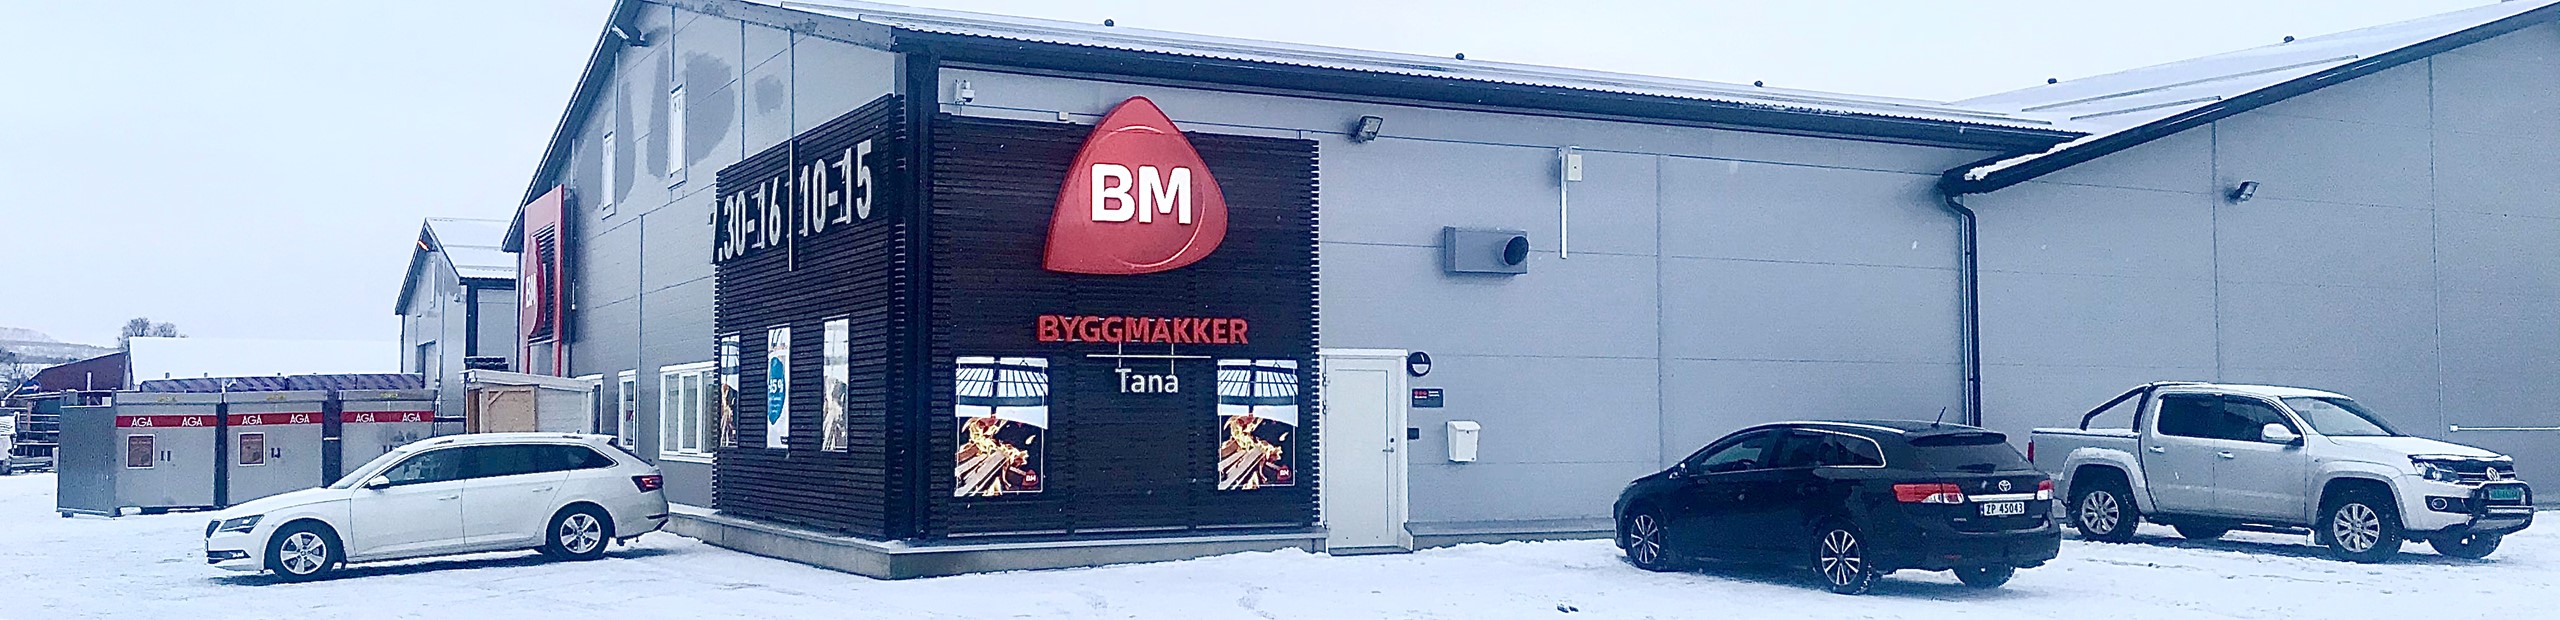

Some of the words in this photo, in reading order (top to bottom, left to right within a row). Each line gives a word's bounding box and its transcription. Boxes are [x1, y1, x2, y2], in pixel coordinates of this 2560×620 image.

[1091, 163, 1192, 225] BM
[1038, 314, 1249, 345] BYGGMAKKER
[1114, 367, 1179, 394] Tana
[131, 416, 153, 427] AGA
[181, 416, 203, 427] AGA
[241, 414, 263, 425] AGA
[289, 412, 310, 424] AGA
[355, 412, 375, 423] AGA
[402, 412, 421, 422] AGA
[1986, 504, 1997, 514] ZP
[1999, 503, 2023, 514] 45043
